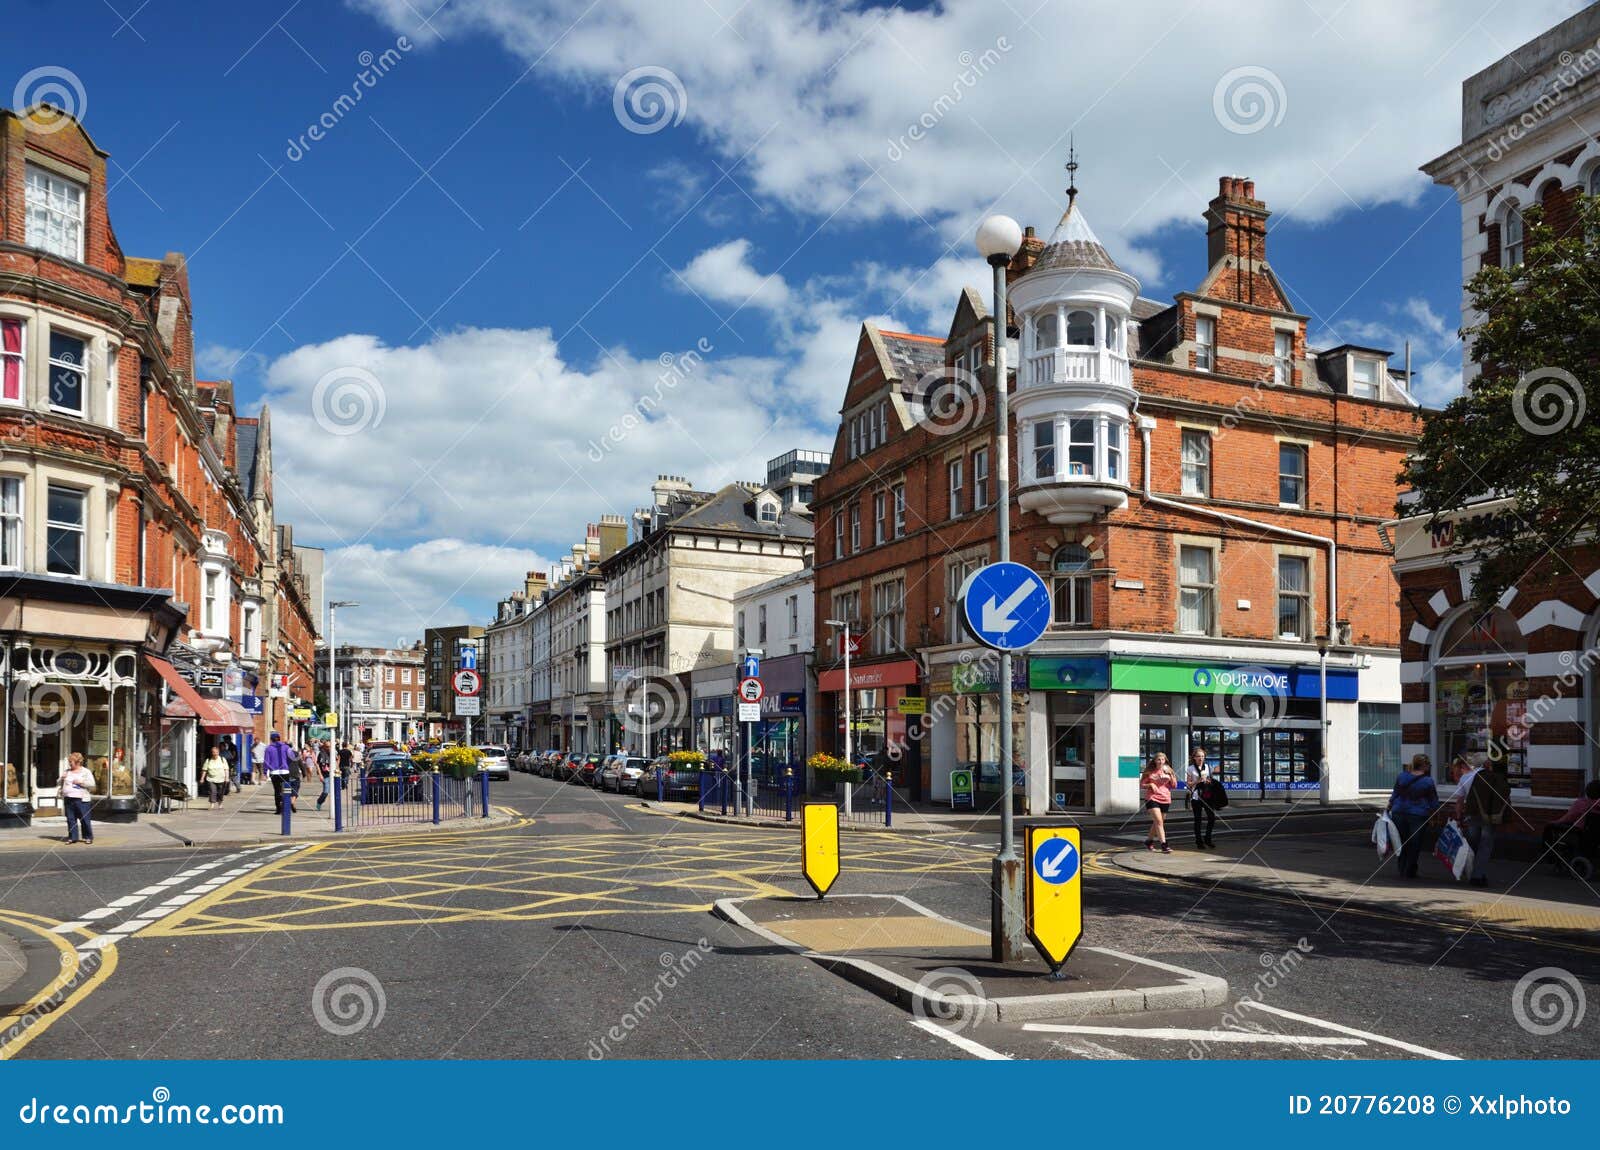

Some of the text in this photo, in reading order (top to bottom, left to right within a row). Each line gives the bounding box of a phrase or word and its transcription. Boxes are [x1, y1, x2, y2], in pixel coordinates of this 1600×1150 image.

[853, 670, 882, 685] Santander
[1213, 672, 1288, 689] YOUR MOVE
